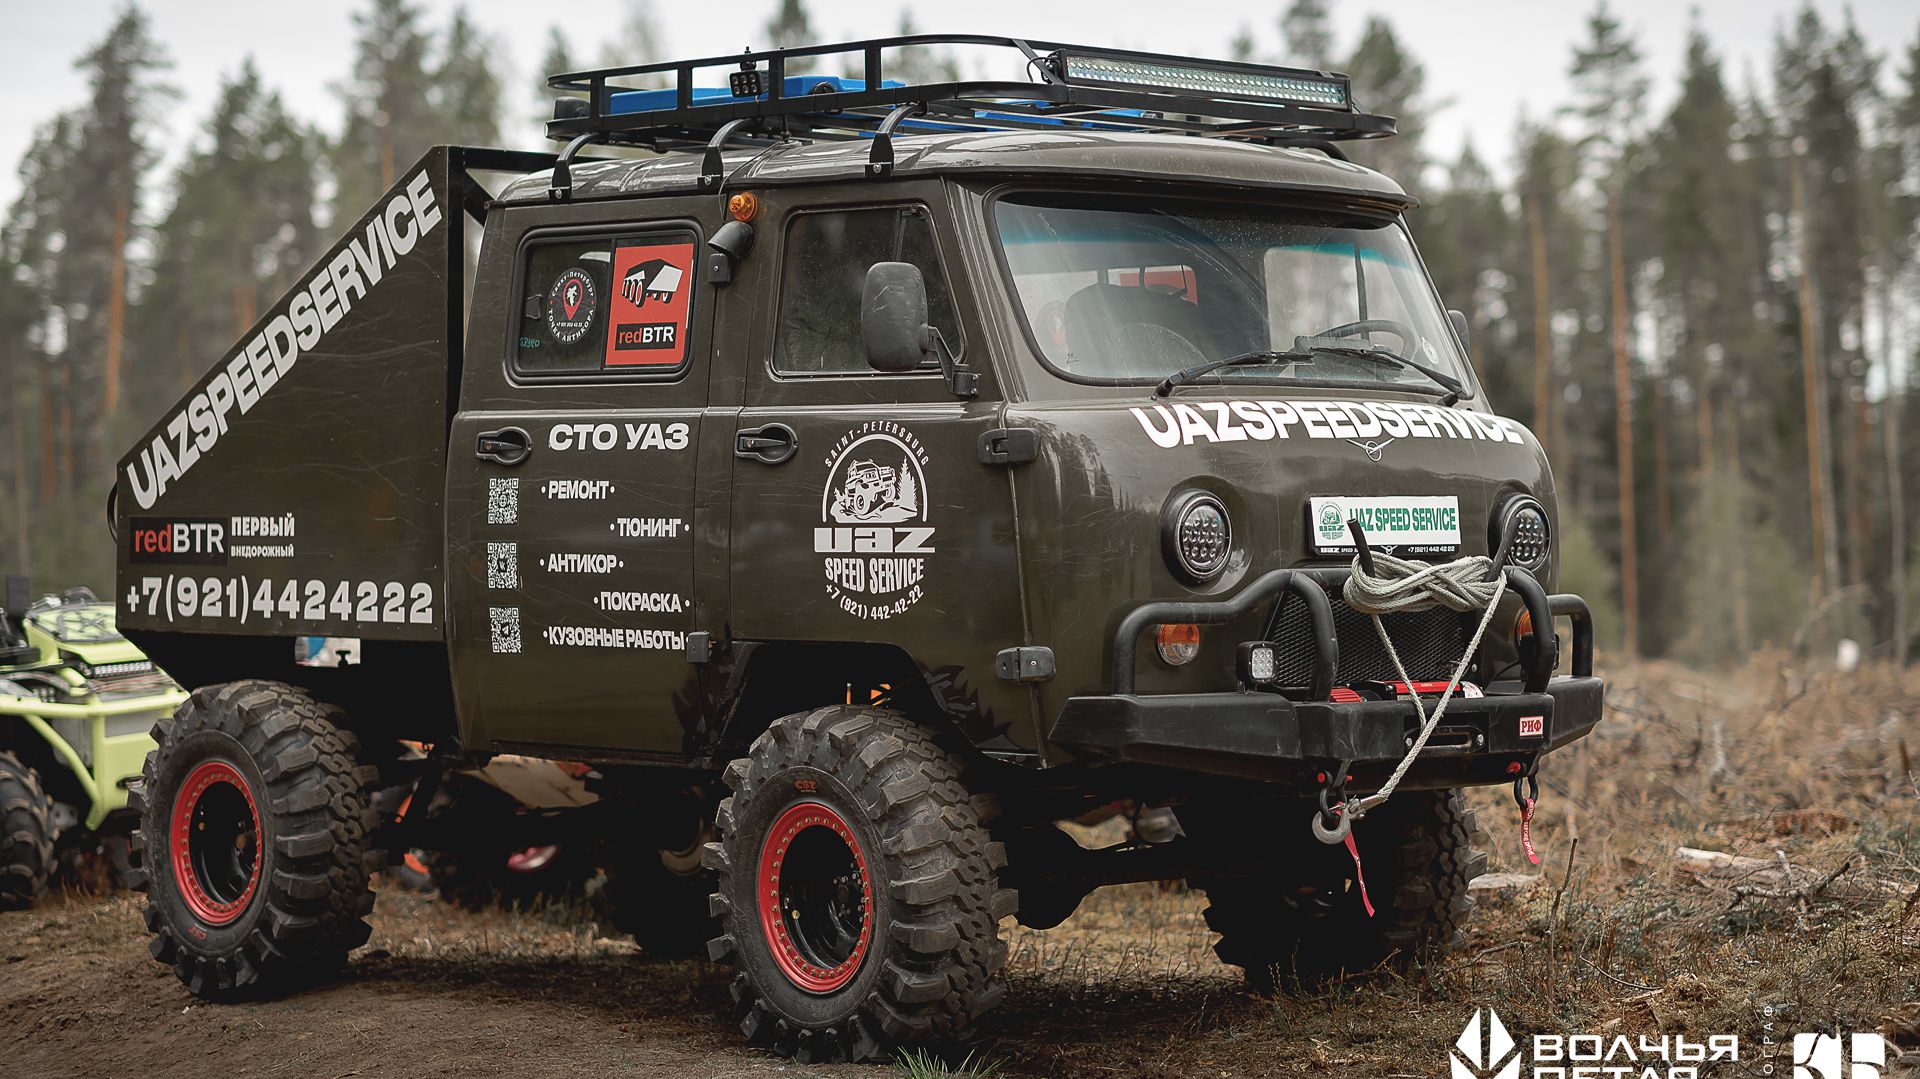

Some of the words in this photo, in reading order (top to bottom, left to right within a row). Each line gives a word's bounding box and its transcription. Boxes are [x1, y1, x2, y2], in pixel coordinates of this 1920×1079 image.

[127, 169, 443, 510] UAZSPEEDSERVICE
[619, 326, 674, 344] redBTR
[549, 423, 618, 450] СТО
[625, 423, 689, 450] УАЗ
[1130, 400, 1525, 448] UAZSPEEDSERVICE
[824, 420, 929, 467] SAINT-PETERSBURG
[231, 512, 295, 537] ПЕРВЫЙ
[1375, 508, 1410, 531] SPEED
[1412, 507, 1456, 531] SERVICE
[134, 523, 224, 553] redBTR
[230, 544, 294, 558] ВНЕДОРОЖНЫЙ
[825, 558, 865, 592] SPEED
[869, 558, 924, 594] SERVICE
[127, 574, 433, 624] +7(921)4424222
[825, 584, 841, 600] +7
[840, 595, 867, 619] (921)
[870, 585, 924, 620] 442-42-22
[1521, 720, 1541, 732] РИФ
